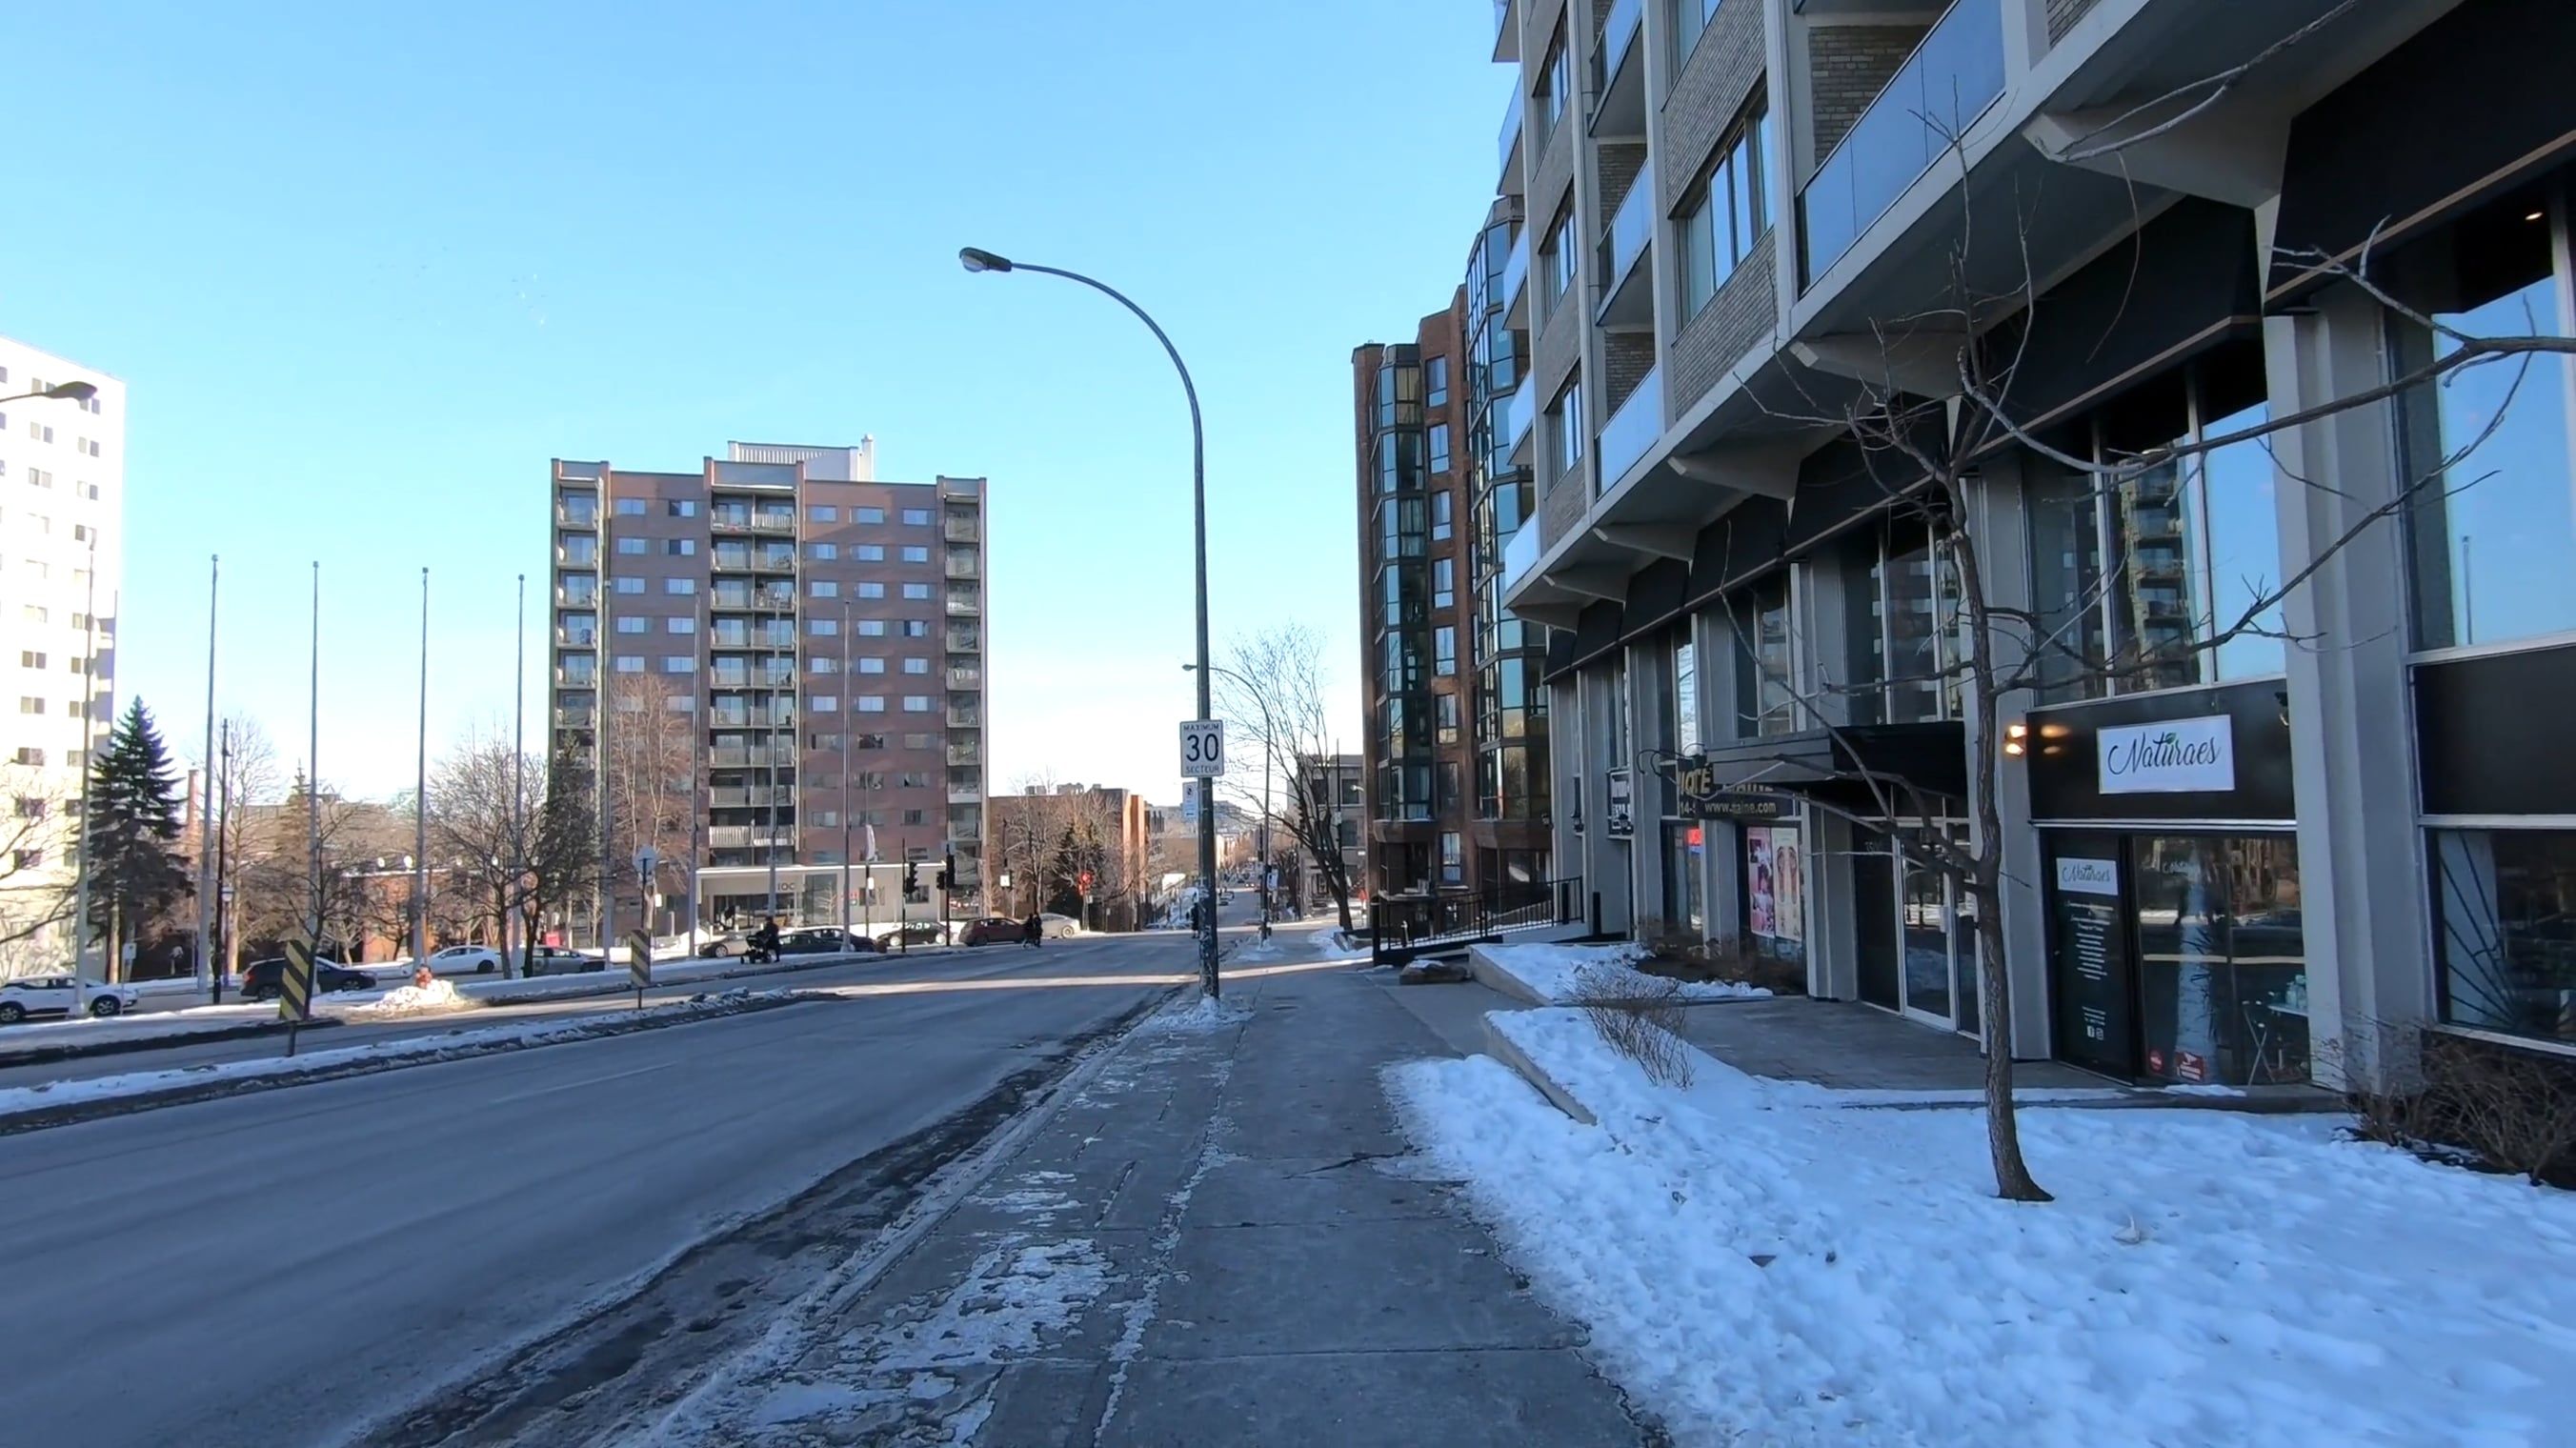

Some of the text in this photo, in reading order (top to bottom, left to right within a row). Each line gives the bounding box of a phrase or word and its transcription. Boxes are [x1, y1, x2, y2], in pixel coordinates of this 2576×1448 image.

[1183, 723, 1219, 732] MAXIMUM
[1186, 733, 1219, 762] 30
[2107, 732, 2222, 774] Naturaes
[1185, 765, 1219, 774] SECTEUR
